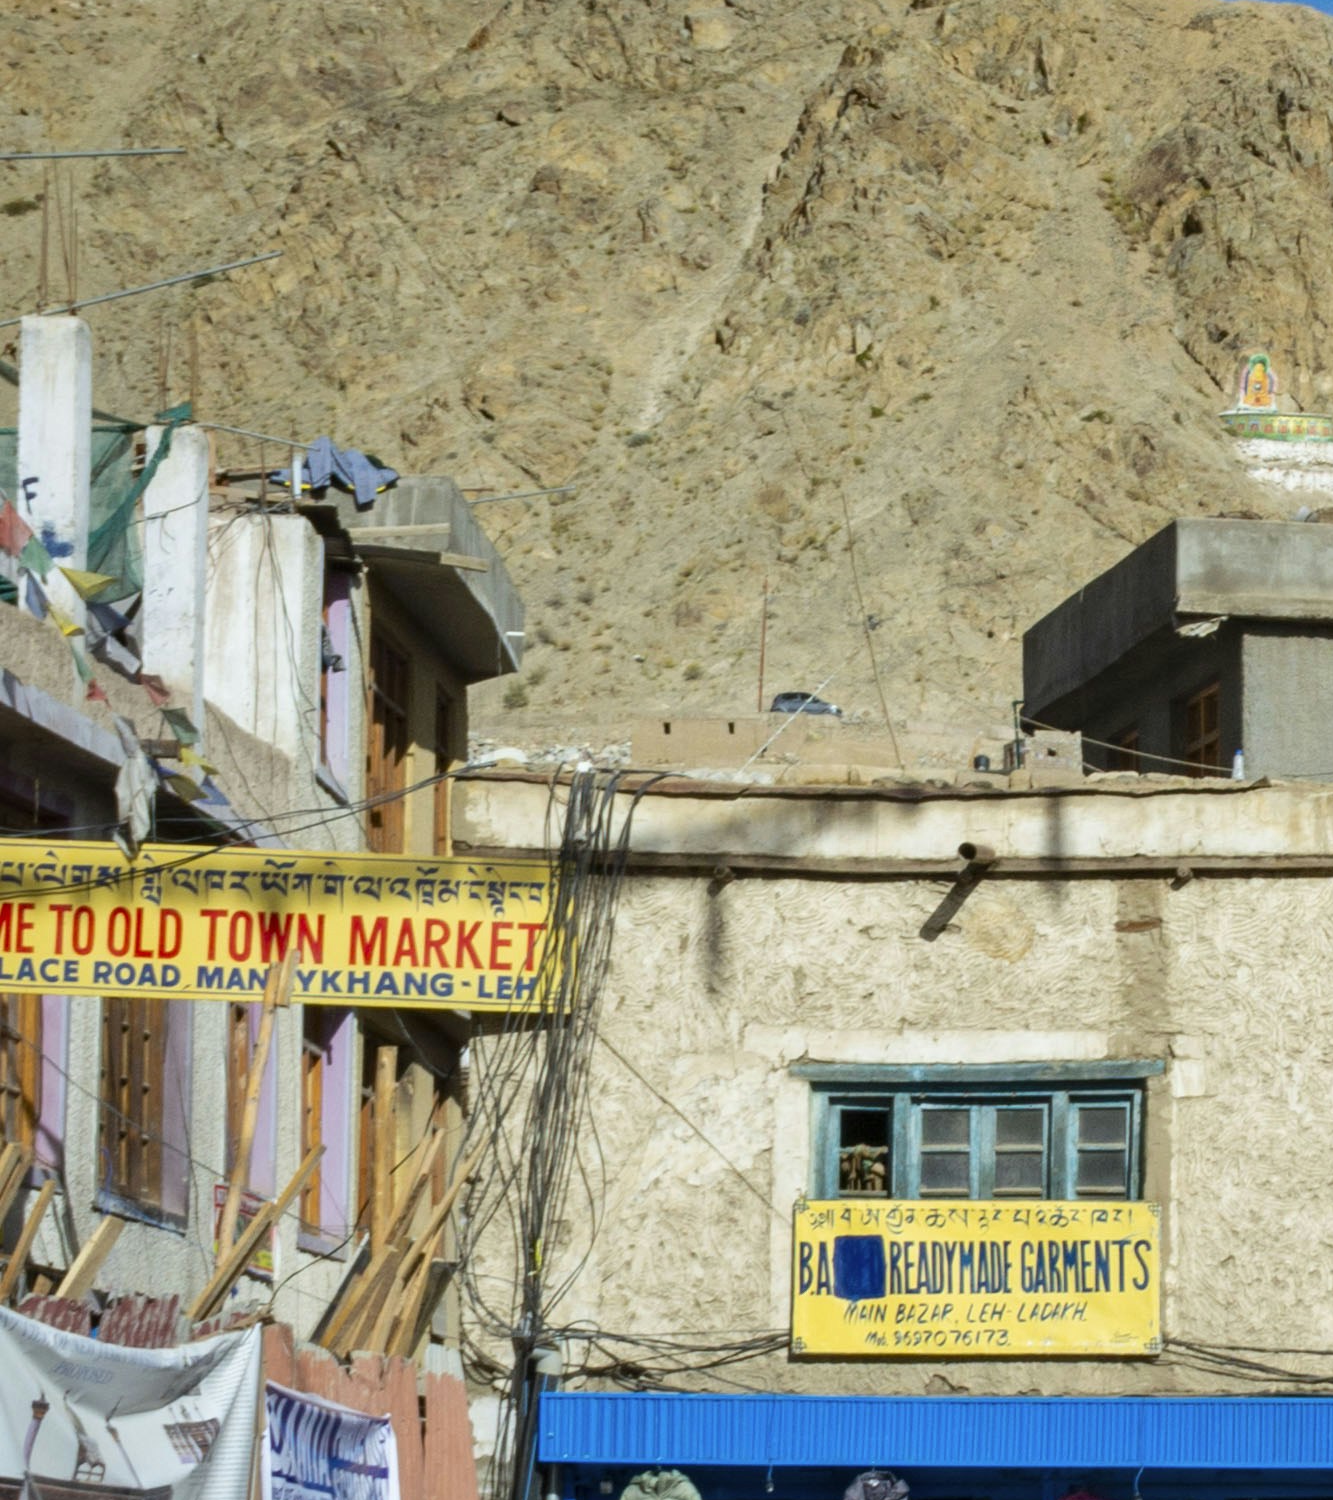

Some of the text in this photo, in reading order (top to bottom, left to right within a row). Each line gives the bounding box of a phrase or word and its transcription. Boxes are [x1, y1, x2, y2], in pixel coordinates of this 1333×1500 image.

[49, 903, 96, 956] TO
[107, 906, 183, 959] OLD
[200, 908, 325, 965] TOWN
[349, 914, 548, 972] MARKET
[197, 965, 454, 997] MANYKHANG
[477, 974, 538, 1000] LEH
[889, 1240, 1012, 1295] READYMADE
[1021, 1239, 1152, 1294] GARMENTS
[844, 1303, 888, 1324] MAIN
